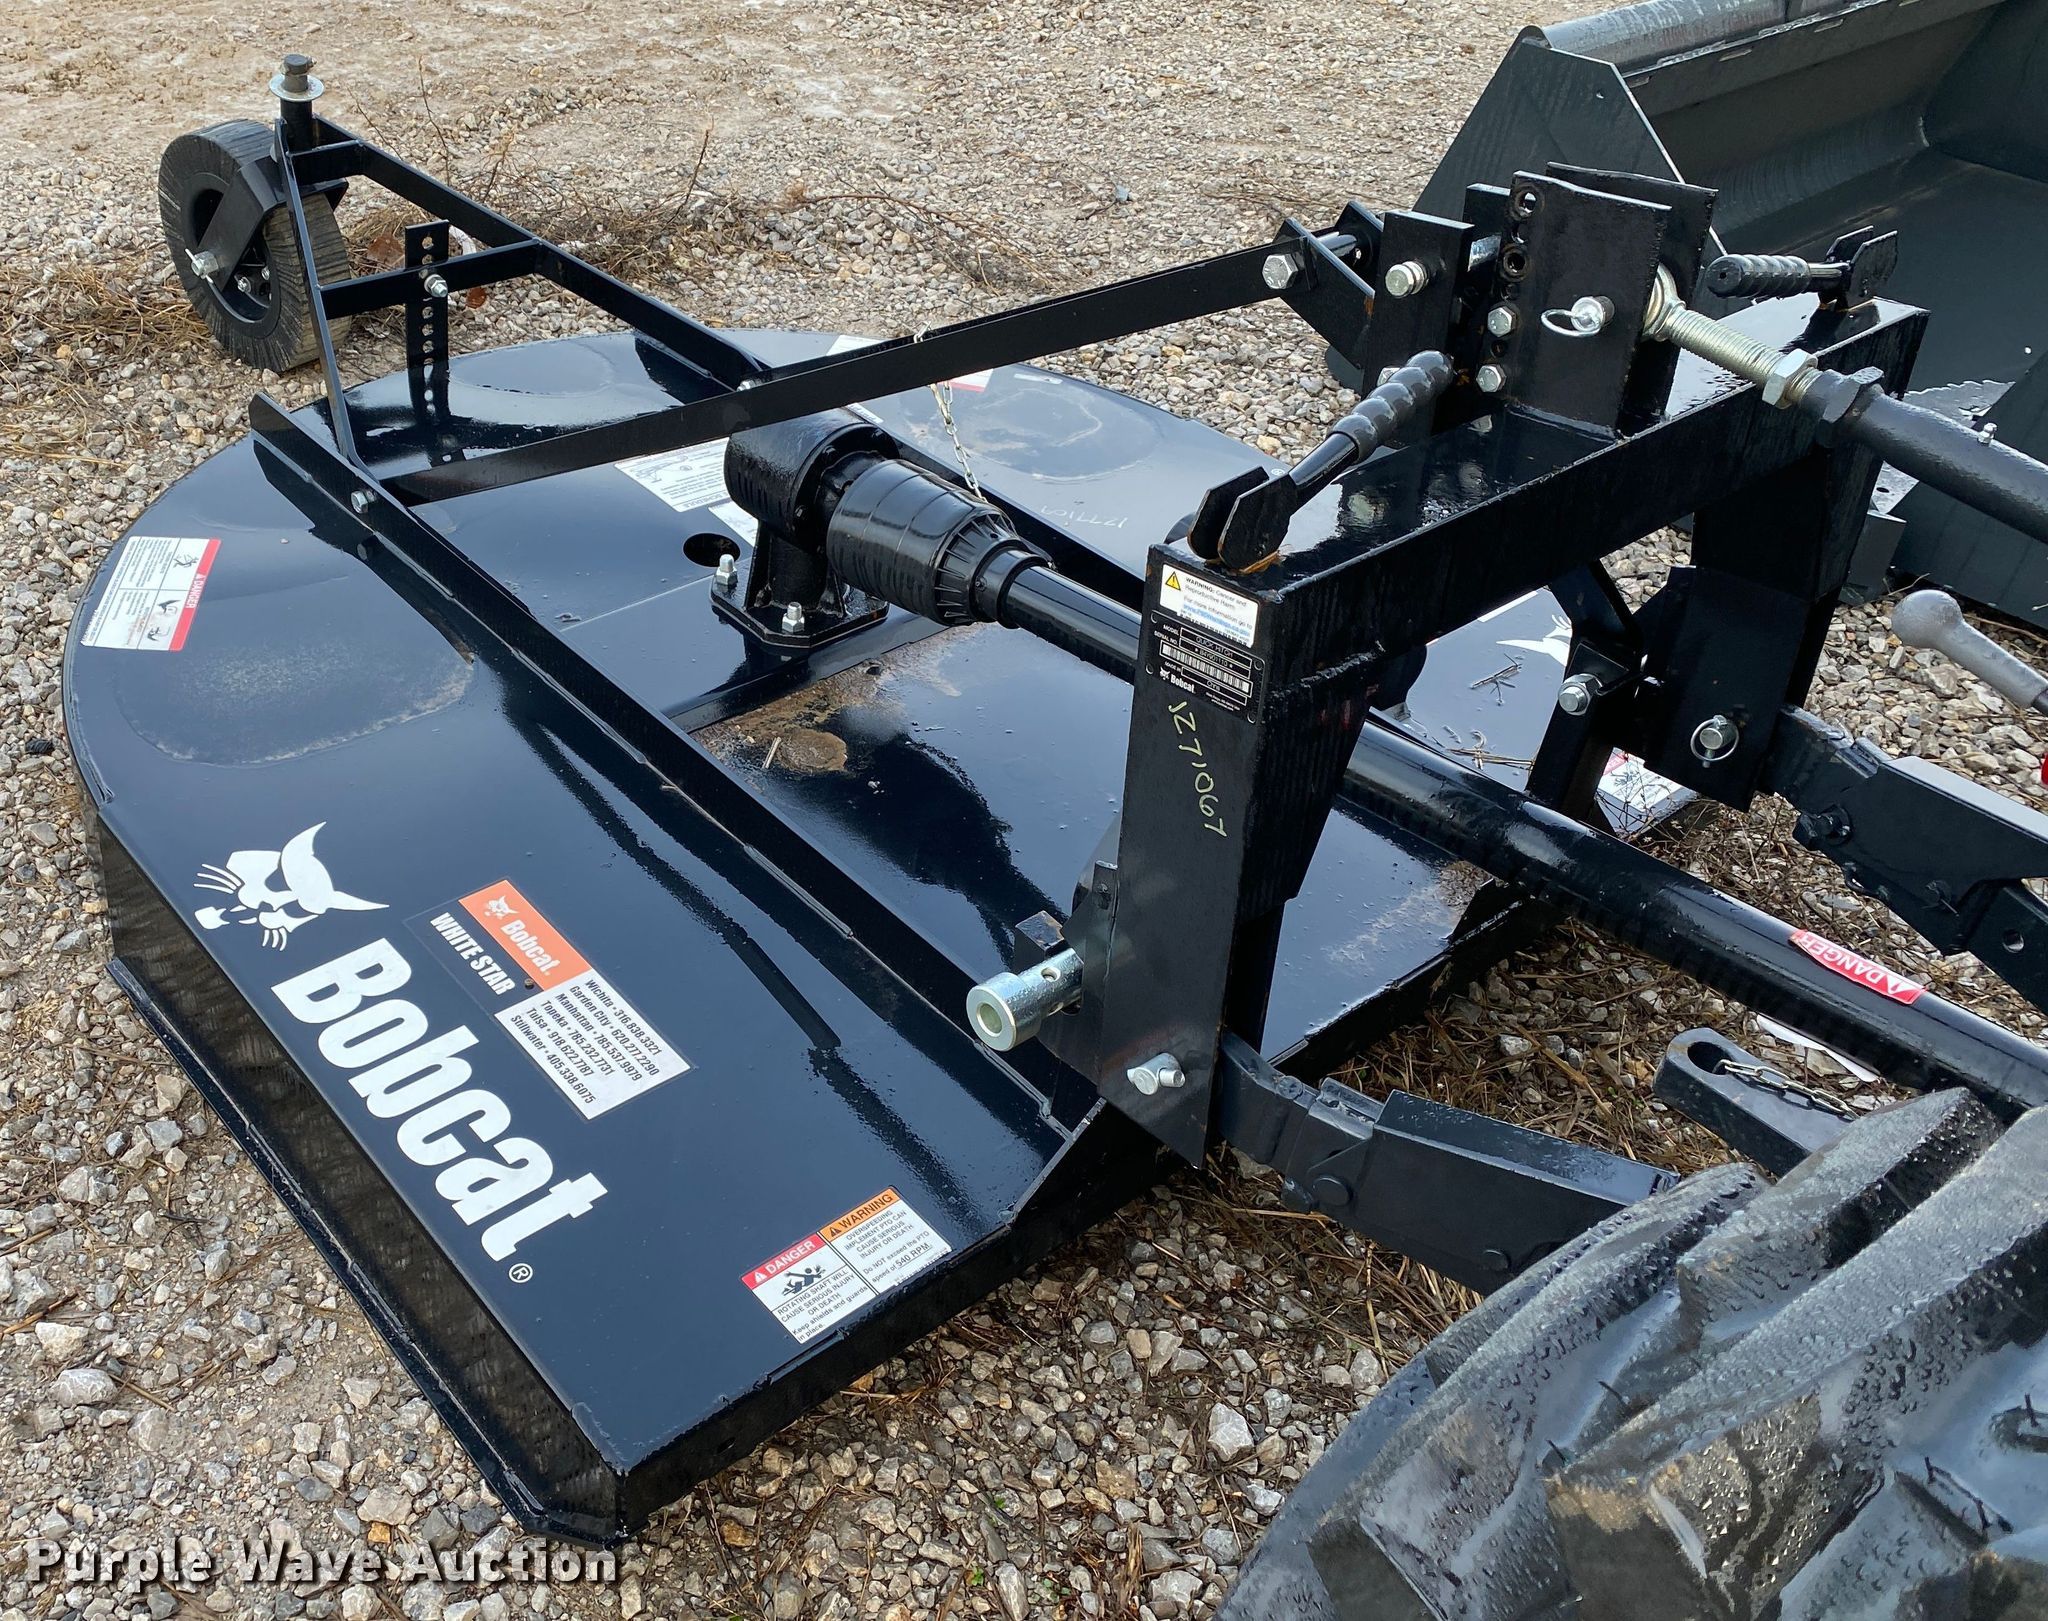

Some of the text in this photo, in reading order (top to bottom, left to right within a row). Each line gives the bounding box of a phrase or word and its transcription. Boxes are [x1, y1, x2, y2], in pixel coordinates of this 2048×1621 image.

[1163, 624, 1180, 636] MODEL
[1171, 674, 1196, 694] Bobcat
[430, 912, 516, 995] WHITE STAR
[501, 919, 561, 976] Bobcat
[1798, 935, 1888, 984] DANGER
[541, 1000, 615, 1076] Topeka 785.232.7731
[555, 993, 643, 1081] Manhattan 785.537.9979
[569, 985, 660, 1076] Garden City 620.277.2290
[585, 979, 663, 1056] Wichita 316.838.3321
[510, 1014, 597, 1104] Stillwater 405.338.6075
[526, 1007, 595, 1077] Tulsa 918.622.7787
[270, 937, 608, 1262] Bobcat
[839, 1193, 894, 1229] WARNING
[844, 1210, 907, 1250] IMPLEMENT PTO CAN
[846, 1210, 893, 1241] OVERSPEEDING
[765, 1240, 816, 1274] DANGER
[856, 1220, 905, 1252] CAUSE SERIOUS
[860, 1224, 914, 1258] INJURY OR DEATH
[863, 1230, 930, 1275] Do NOT exceed the PTO
[777, 1268, 849, 1316] ROTATING SHAFT WILL
[872, 1268, 890, 1283] speed
[895, 1254, 911, 1267] 540
[781, 1274, 855, 1322] CAUSE SERIOUS INJURY
[792, 1286, 868, 1336] Keep shields and guards
[808, 1293, 841, 1316] OR DEATH
[797, 1334, 805, 1342] in
